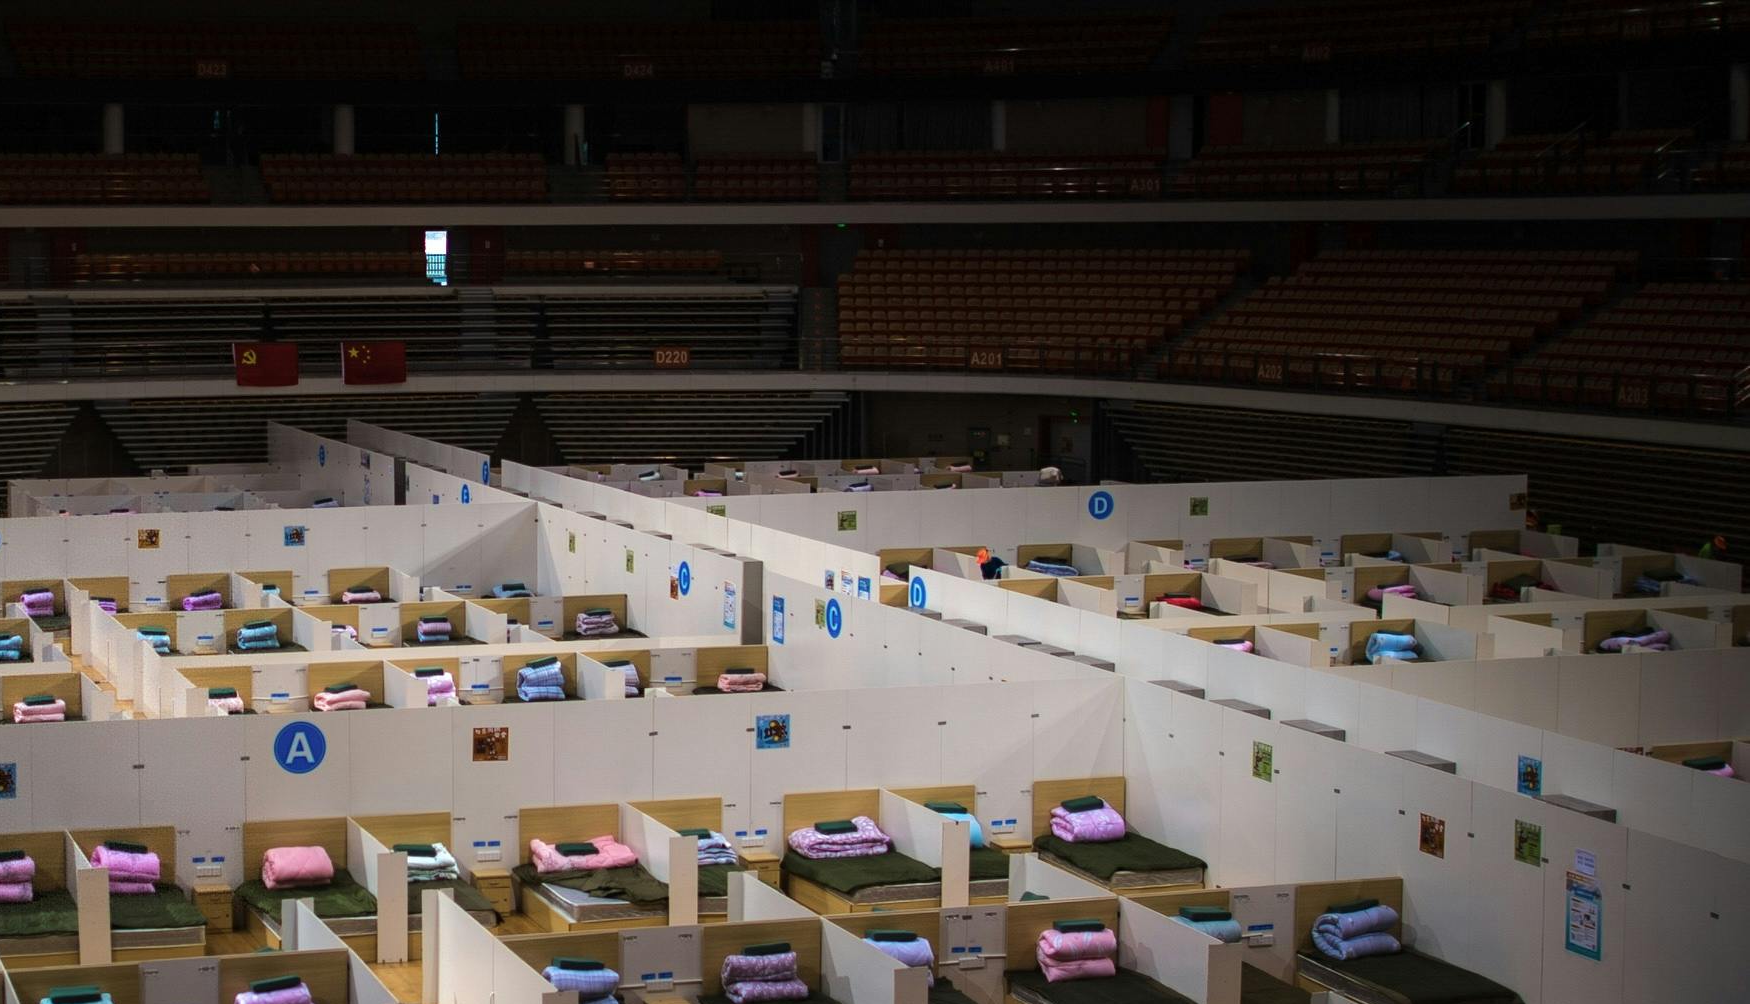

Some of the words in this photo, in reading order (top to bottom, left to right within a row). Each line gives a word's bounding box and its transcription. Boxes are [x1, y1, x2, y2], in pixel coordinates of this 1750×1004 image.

[1130, 177, 1161, 191] A301
[655, 351, 688, 364] D220
[970, 352, 1003, 367] A201
[1257, 364, 1283, 380] A202
[1618, 387, 1649, 403] A203
[1094, 497, 1107, 514] D
[680, 567, 688, 589] C
[910, 583, 922, 606] D
[829, 608, 839, 631] C
[285, 731, 315, 764] A
